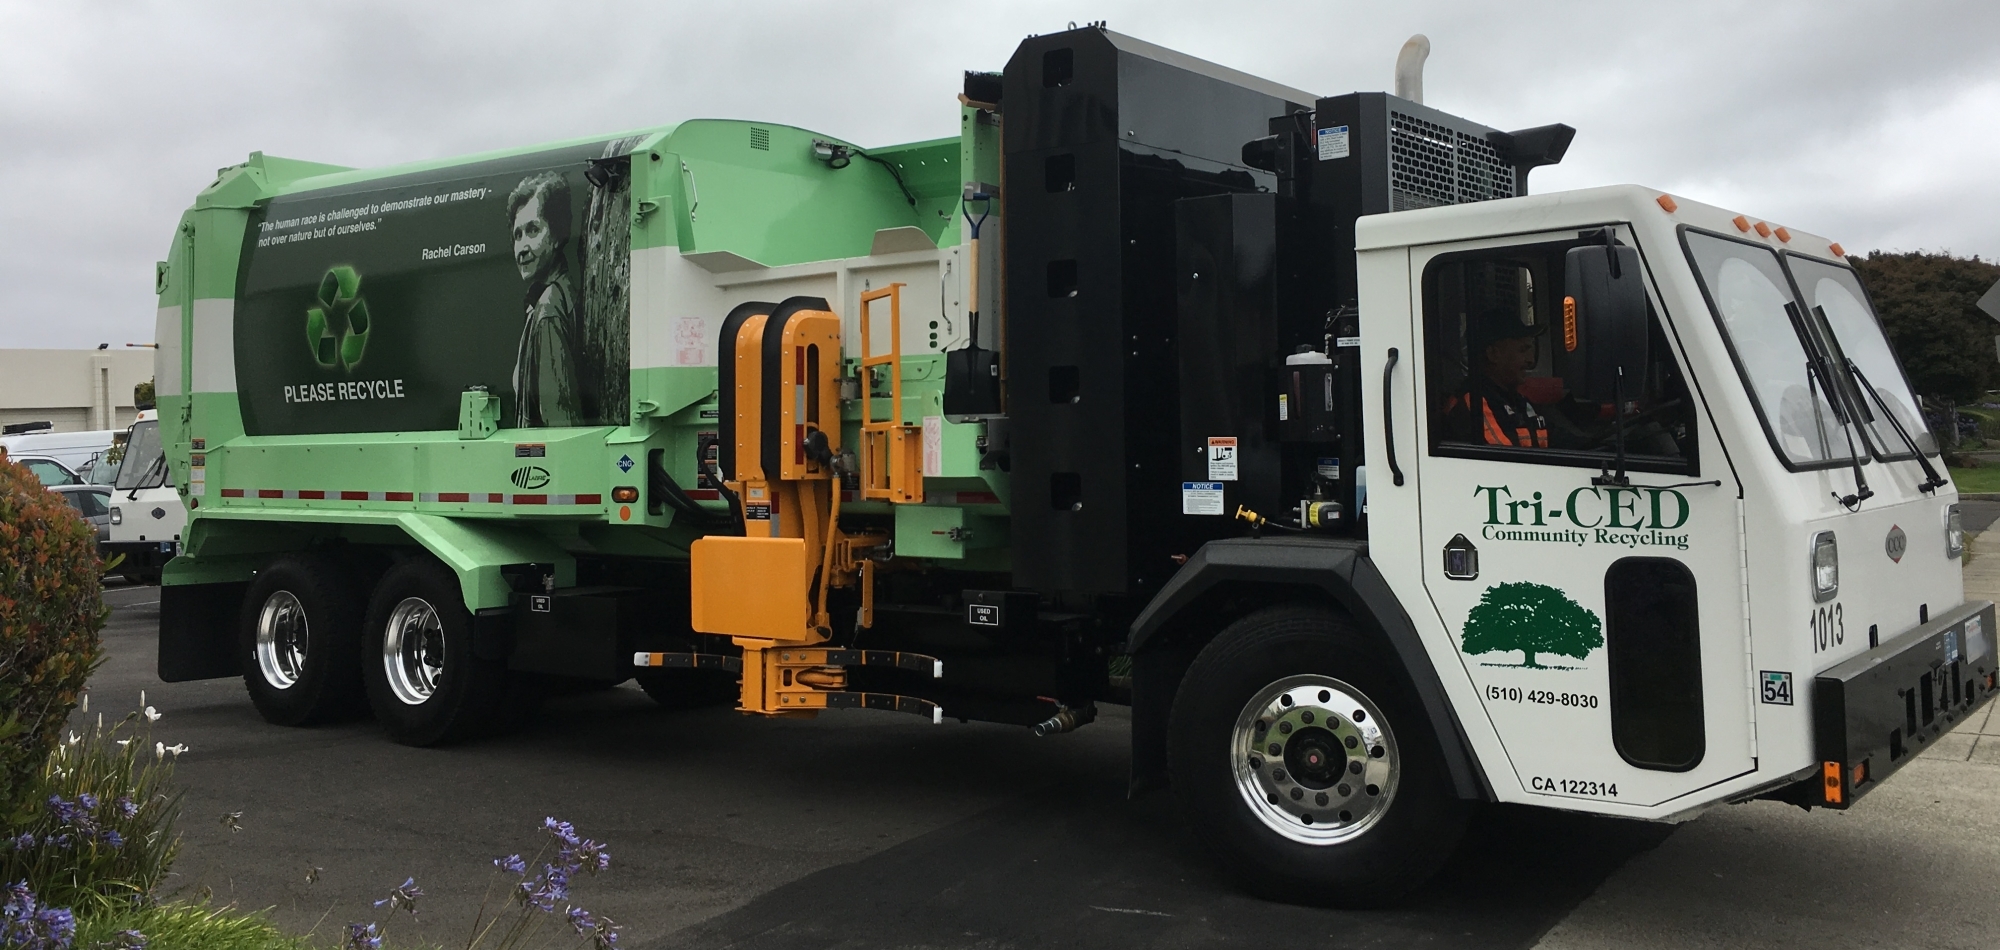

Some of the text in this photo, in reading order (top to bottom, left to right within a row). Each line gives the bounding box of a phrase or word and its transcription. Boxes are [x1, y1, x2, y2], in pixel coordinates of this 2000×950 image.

[275, 218, 299, 230] human
[301, 214, 317, 226] race
[318, 212, 326, 223] is
[327, 204, 370, 220] challenged
[371, 204, 379, 214] to
[380, 195, 432, 213] demonstrate
[433, 193, 449, 204] our
[450, 187, 487, 202] mastery
[258, 236, 271, 248] not
[271, 235, 288, 245] over
[288, 230, 312, 243] nature
[313, 227, 327, 239] but
[327, 225, 336, 237] of
[422, 243, 486, 260] Rachel Carson
[284, 379, 405, 403] PLEASE RECYCLE
[617, 460, 633, 468] CNG
[1473, 484, 1690, 532] Tri-CED
[1482, 525, 1690, 551] Community Recycling
[1810, 602, 1844, 654] 1013
[1486, 684, 1599, 709] (510) 429-8030
[1764, 680, 1790, 702] 54
[1531, 776, 1618, 797] CA 122314
